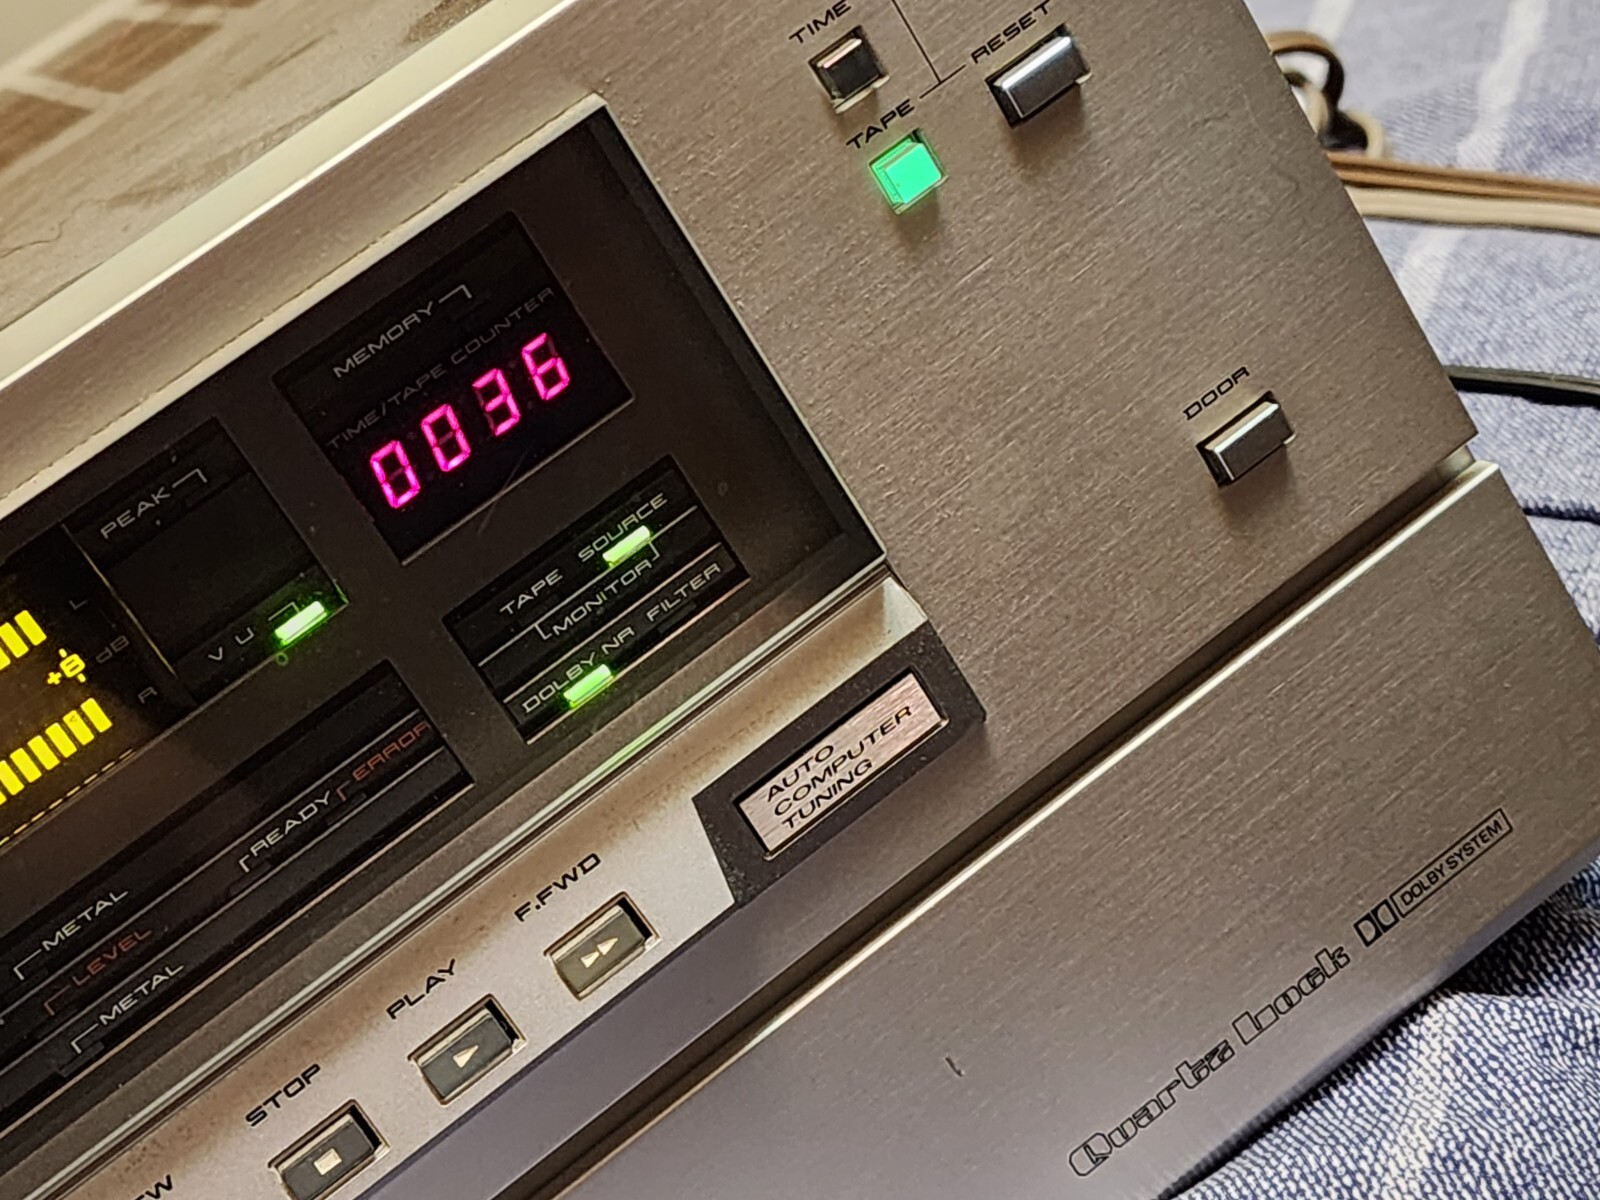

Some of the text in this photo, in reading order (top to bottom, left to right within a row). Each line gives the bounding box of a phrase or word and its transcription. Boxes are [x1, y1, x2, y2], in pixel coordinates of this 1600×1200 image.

[789, 0, 851, 44] TIME
[970, 0, 1049, 64] RESET
[846, 98, 915, 150] TAPE
[327, 286, 555, 450] TIME/TAPE COUNTER
[332, 302, 433, 378] MEMORY
[370, 332, 570, 508] 0036
[1183, 366, 1250, 420] DOOR
[100, 485, 171, 540] PEAK
[500, 493, 669, 615] TAPE SOURCE
[551, 558, 653, 637] MONITOR
[95, 635, 130, 664] dB
[522, 562, 722, 714] DOLBY NR FILTER
[352, 721, 430, 782] ERROR
[766, 744, 835, 803] AUTO
[773, 705, 913, 817] COMPUTER
[249, 790, 332, 858] READY
[780, 757, 874, 829] TUNING
[513, 852, 602, 923] F.FWD
[1399, 818, 1505, 907] DOLBY SYSTEM
[40, 889, 129, 952] METAL
[71, 928, 152, 986] LEVEL
[385, 958, 457, 1020] PLAY
[99, 964, 185, 1026] METAL
[244, 1063, 321, 1128] STOP
[1068, 1040, 1236, 1177] Quartz
